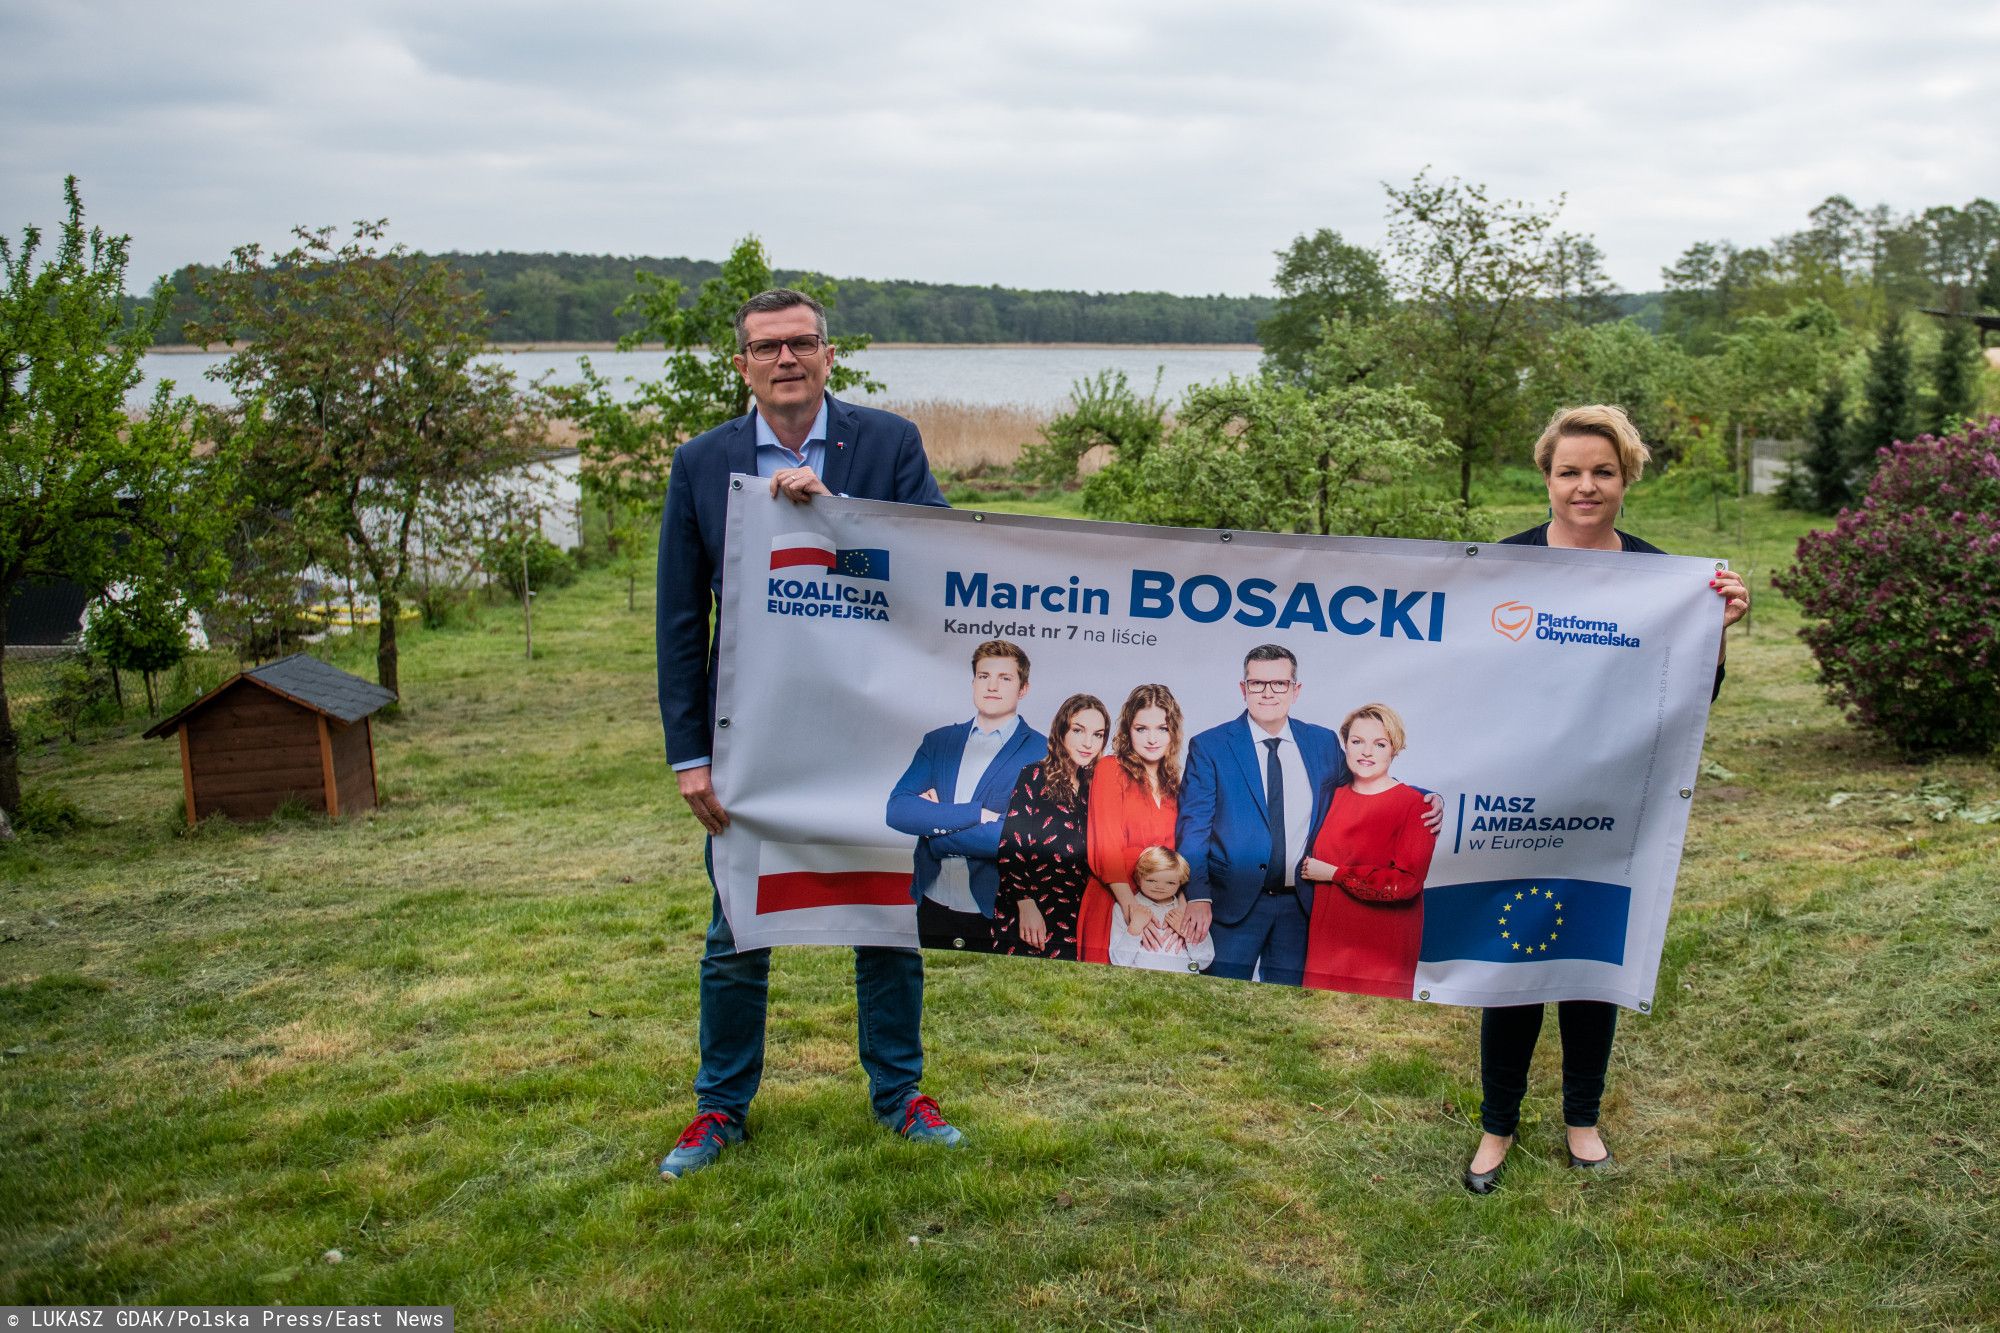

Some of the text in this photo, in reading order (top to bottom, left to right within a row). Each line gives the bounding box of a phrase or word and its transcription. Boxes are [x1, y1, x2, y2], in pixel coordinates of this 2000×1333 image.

[768, 578, 889, 608] KOALICJA
[767, 599, 890, 622] EUROPEJSKA
[945, 568, 1445, 642] Marcin BOSACKI
[944, 618, 1158, 647] Kandydat nr 7 na liście
[1537, 612, 1618, 633] Platforma
[1535, 627, 1641, 649] Obywatelska
[1474, 794, 1536, 812] NASZ
[1470, 815, 1615, 832] AMBASADOR
[1469, 834, 1564, 852] w Europie
